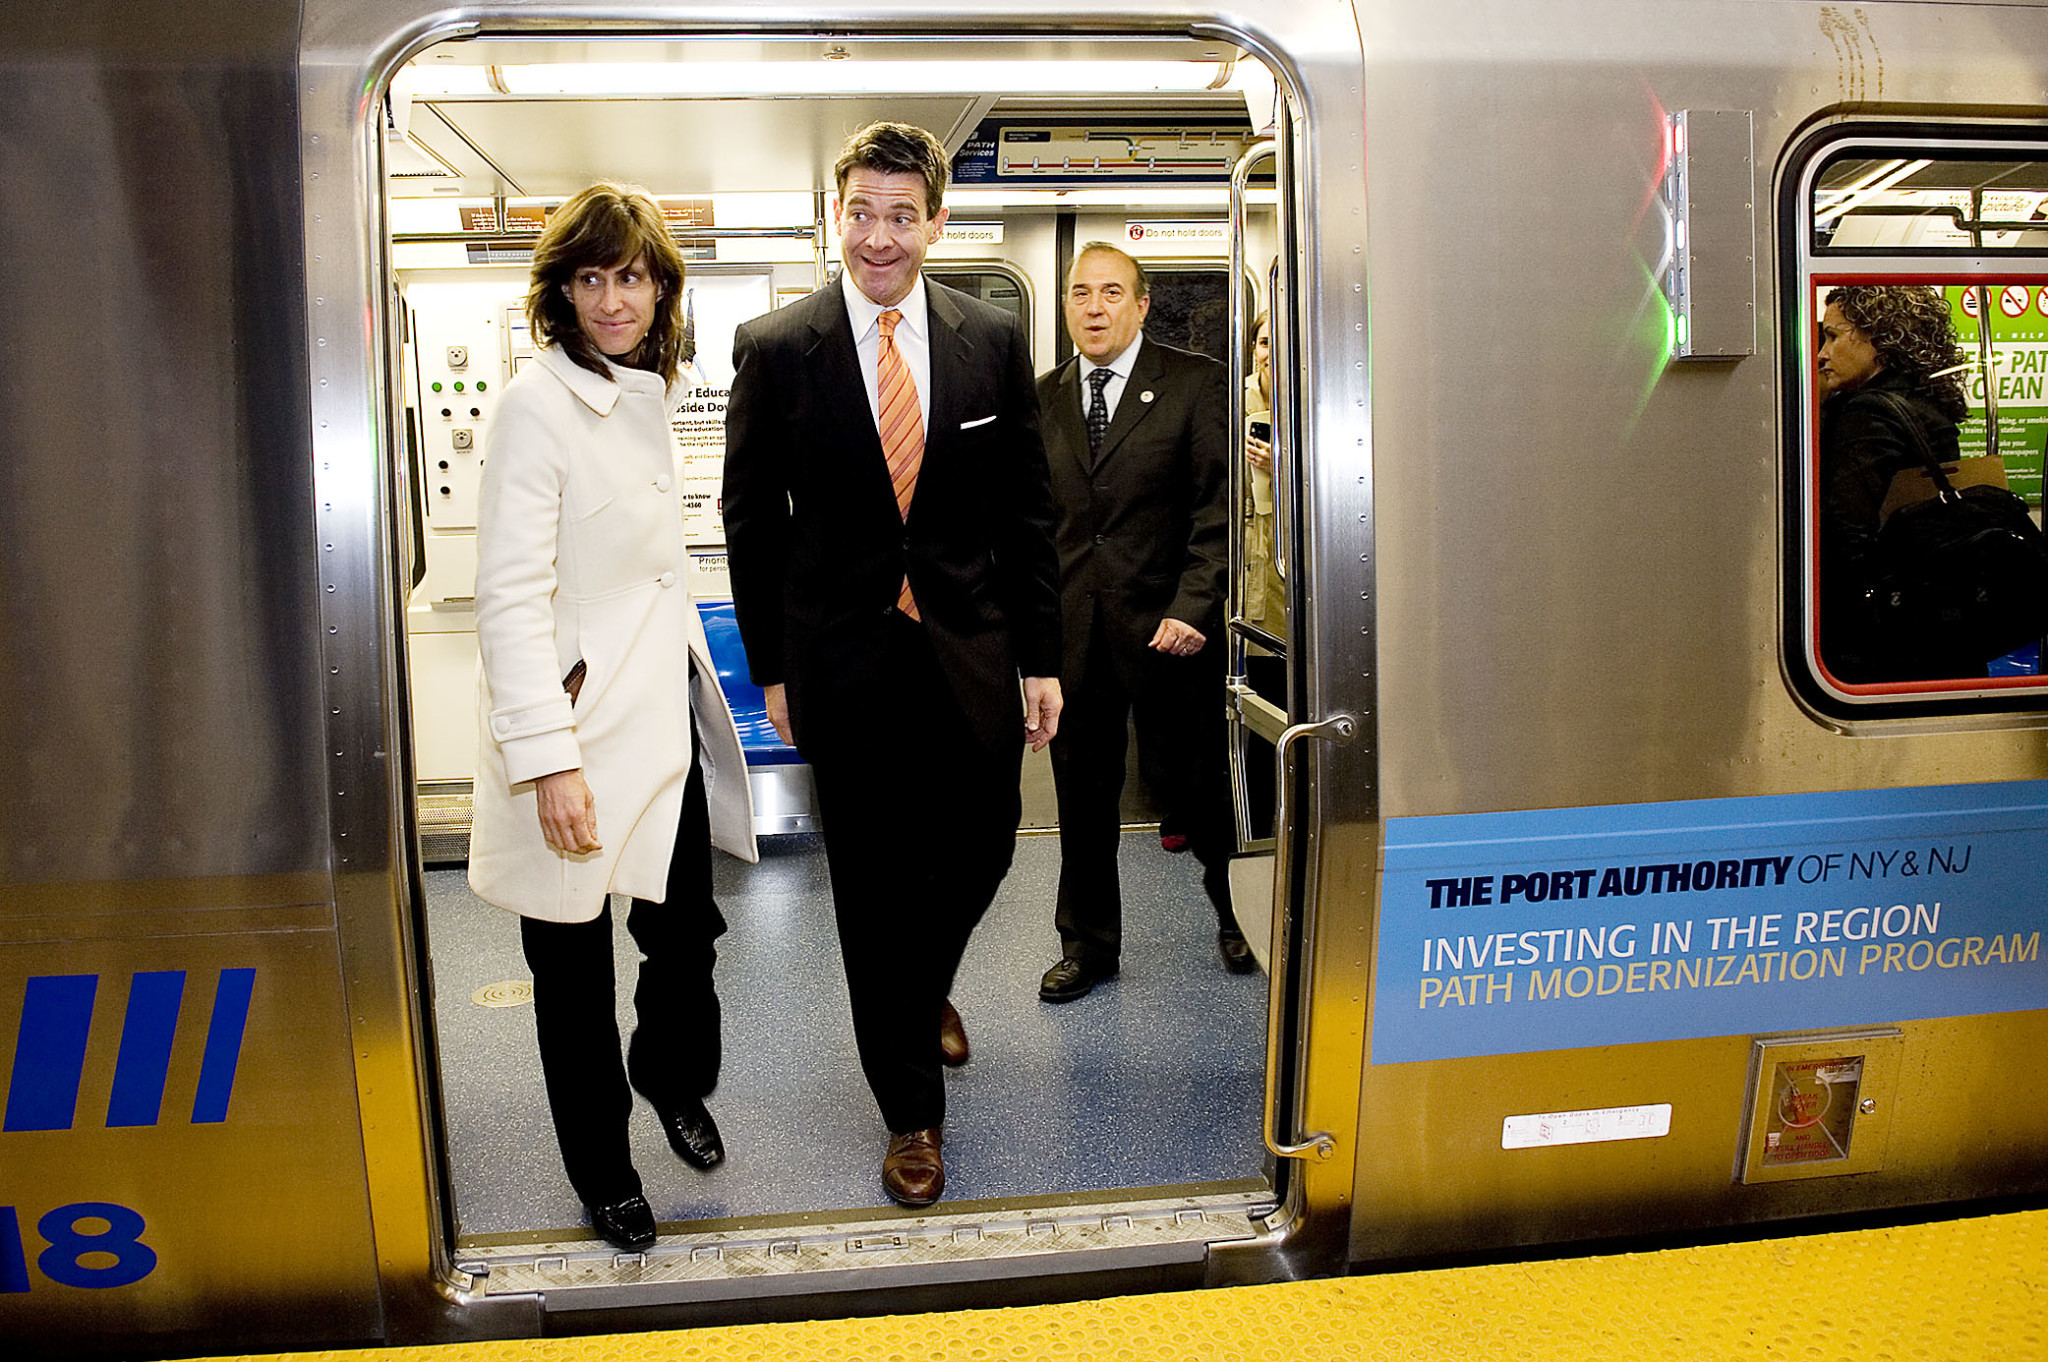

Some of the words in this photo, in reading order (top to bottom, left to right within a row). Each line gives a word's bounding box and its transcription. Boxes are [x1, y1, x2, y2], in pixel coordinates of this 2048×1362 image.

[959, 149, 995, 157] Services
[946, 231, 966, 240] hold
[968, 231, 994, 240] doors
[1145, 228, 1159, 238] Do
[1161, 229, 1175, 237] not
[1177, 228, 1196, 237] hold
[1197, 228, 1223, 237] doors
[1972, 376, 2044, 400] CEAN
[1426, 876, 1494, 909] THE
[1500, 869, 1597, 904] PORT
[1597, 856, 1794, 898] AUTHORITY
[1797, 853, 1843, 884] OF
[1849, 850, 1899, 880] NY
[1901, 850, 1919, 876] &
[1927, 845, 1971, 875] NJ
[1422, 924, 1637, 972] INVESTING
[1651, 920, 1693, 955] IN
[1706, 914, 1782, 950] THE
[1794, 902, 1941, 944] REGION
[1419, 972, 1514, 1009] PATH
[1528, 947, 1847, 1001] MODERNIZATION
[1859, 931, 2041, 975] PROGRAM
